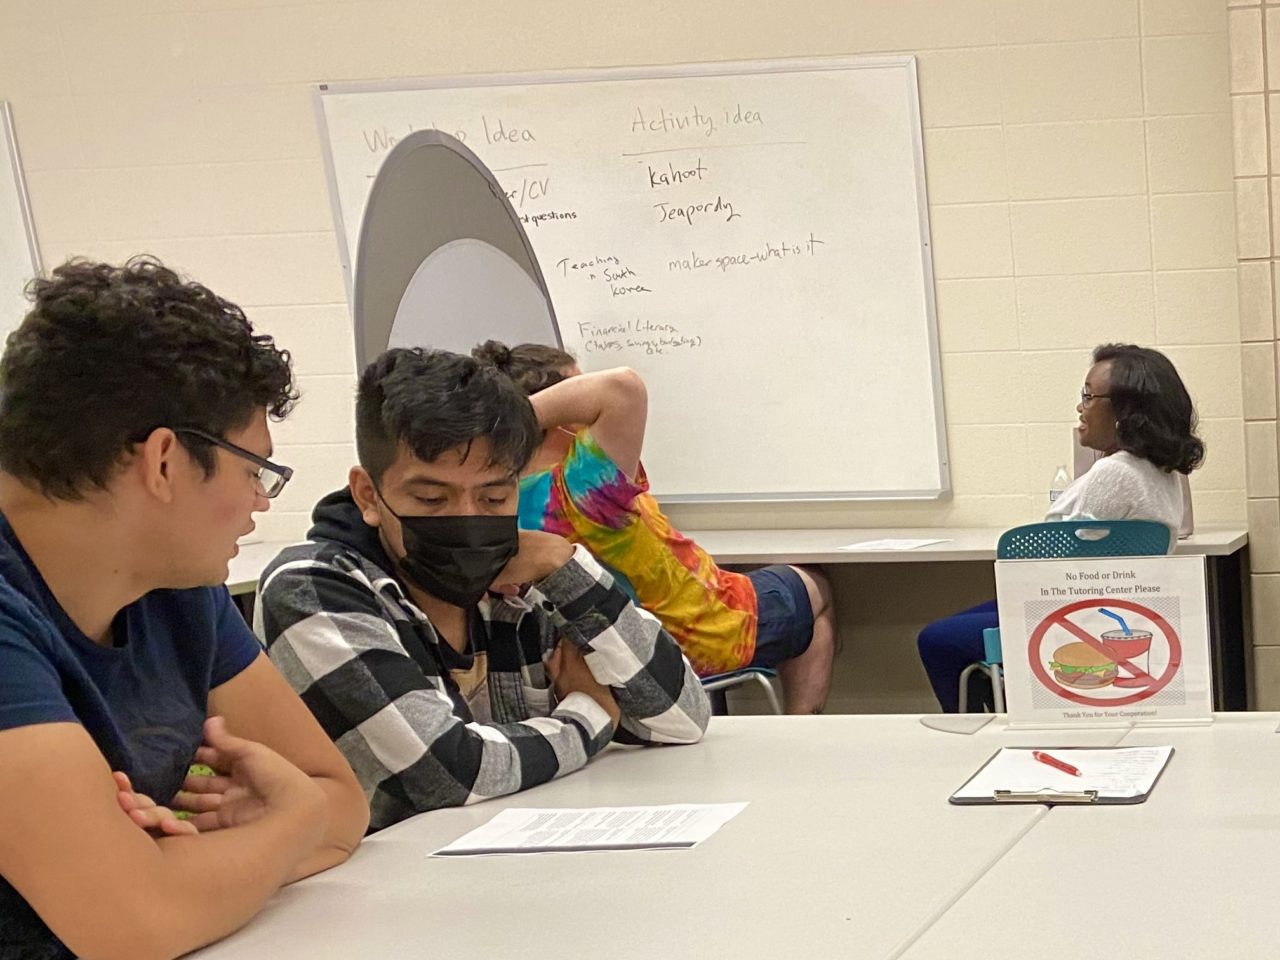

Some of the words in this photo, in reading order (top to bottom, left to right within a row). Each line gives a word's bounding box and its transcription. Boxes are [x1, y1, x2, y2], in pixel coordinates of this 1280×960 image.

[632, 105, 717, 136] Activity
[725, 104, 764, 125] idea
[482, 116, 536, 144] Idea
[531, 211, 577, 227] questions
[653, 196, 741, 225] Jeapordy
[556, 256, 620, 277] Teaching
[603, 267, 636, 282] South
[577, 320, 631, 338] Financial
[635, 319, 679, 333] Literacy
[1065, 572, 1077, 580] No
[1079, 571, 1100, 580] Food
[1112, 570, 1136, 579] Drink
[1040, 587, 1049, 596] In
[1051, 587, 1066, 596] The
[1068, 586, 1104, 597] Tutoring
[1105, 585, 1132, 594] Center
[1134, 584, 1160, 593] Please
